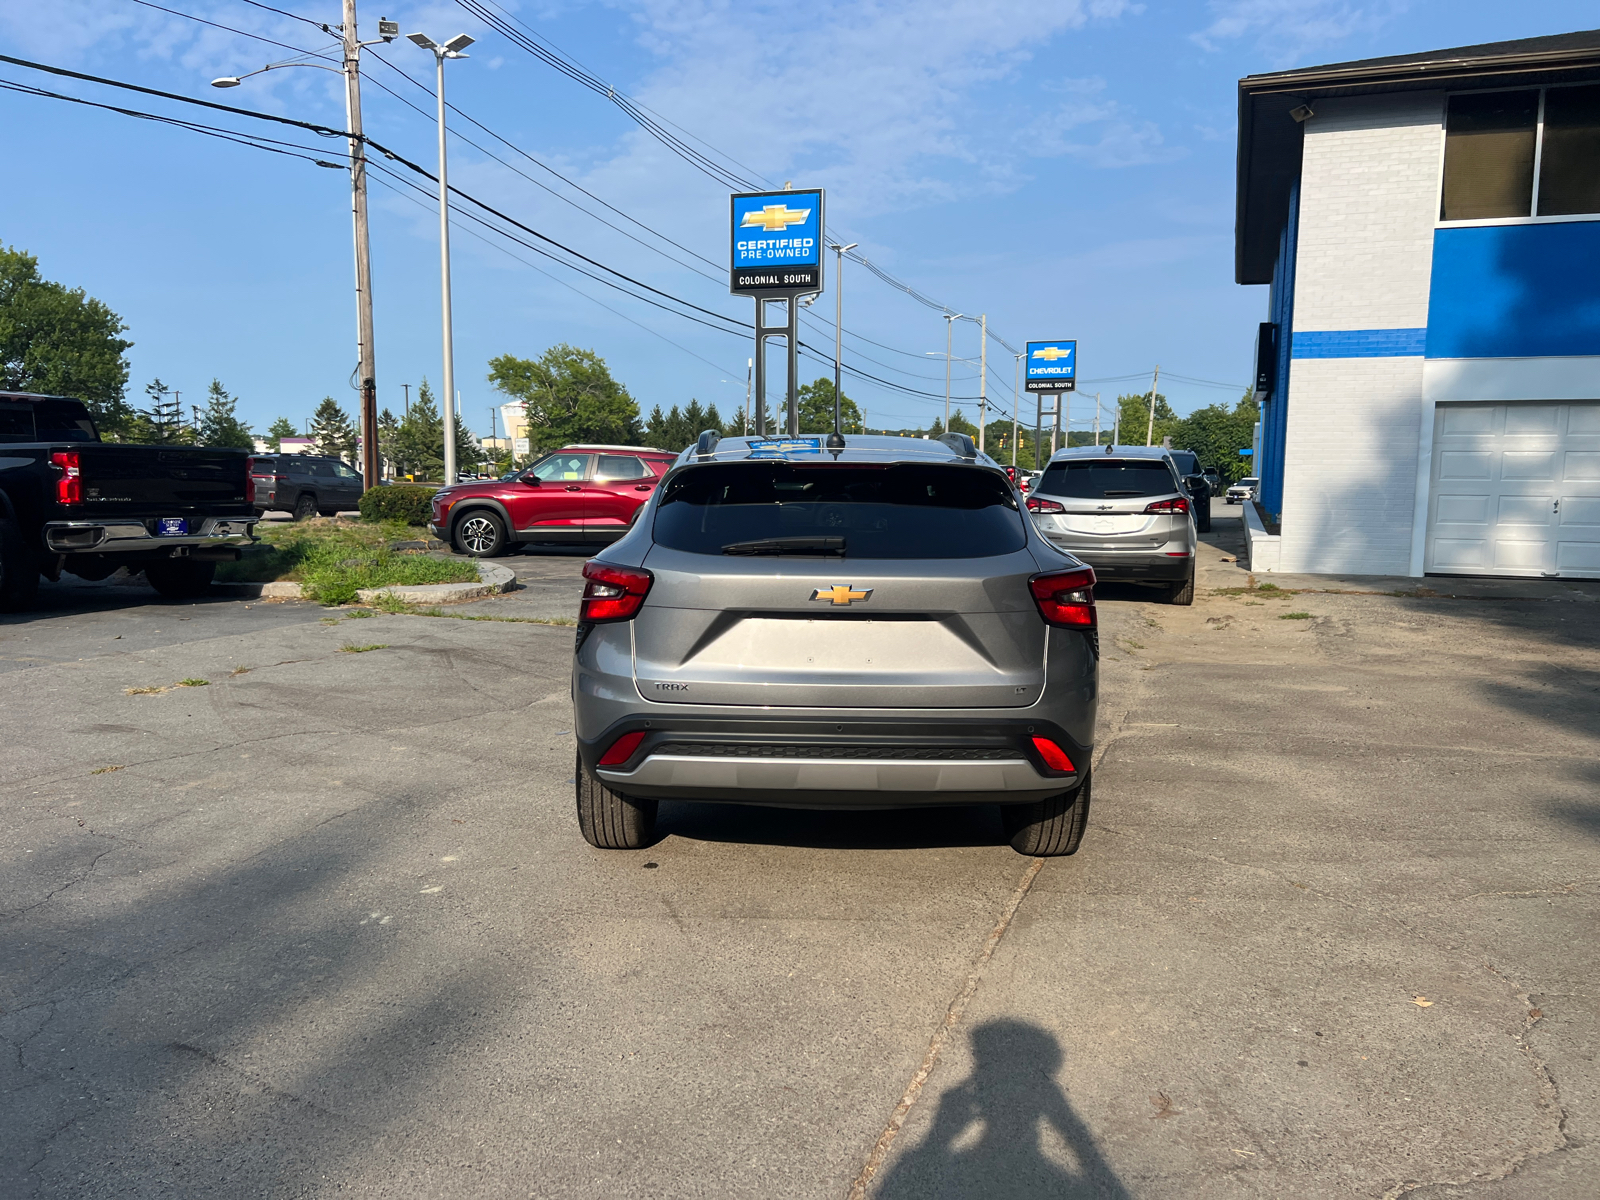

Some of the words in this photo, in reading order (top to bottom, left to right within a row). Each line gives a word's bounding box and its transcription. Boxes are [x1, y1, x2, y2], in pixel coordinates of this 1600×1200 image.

[737, 238, 814, 250] CERTIFIED
[741, 248, 810, 259] PRE-OWNED
[739, 275, 780, 285] COLONIAL
[784, 274, 811, 283] SOUTH
[1029, 367, 1073, 375] CHEVROLET
[654, 682, 690, 691] TRAX
[1015, 687, 1027, 695] LT
